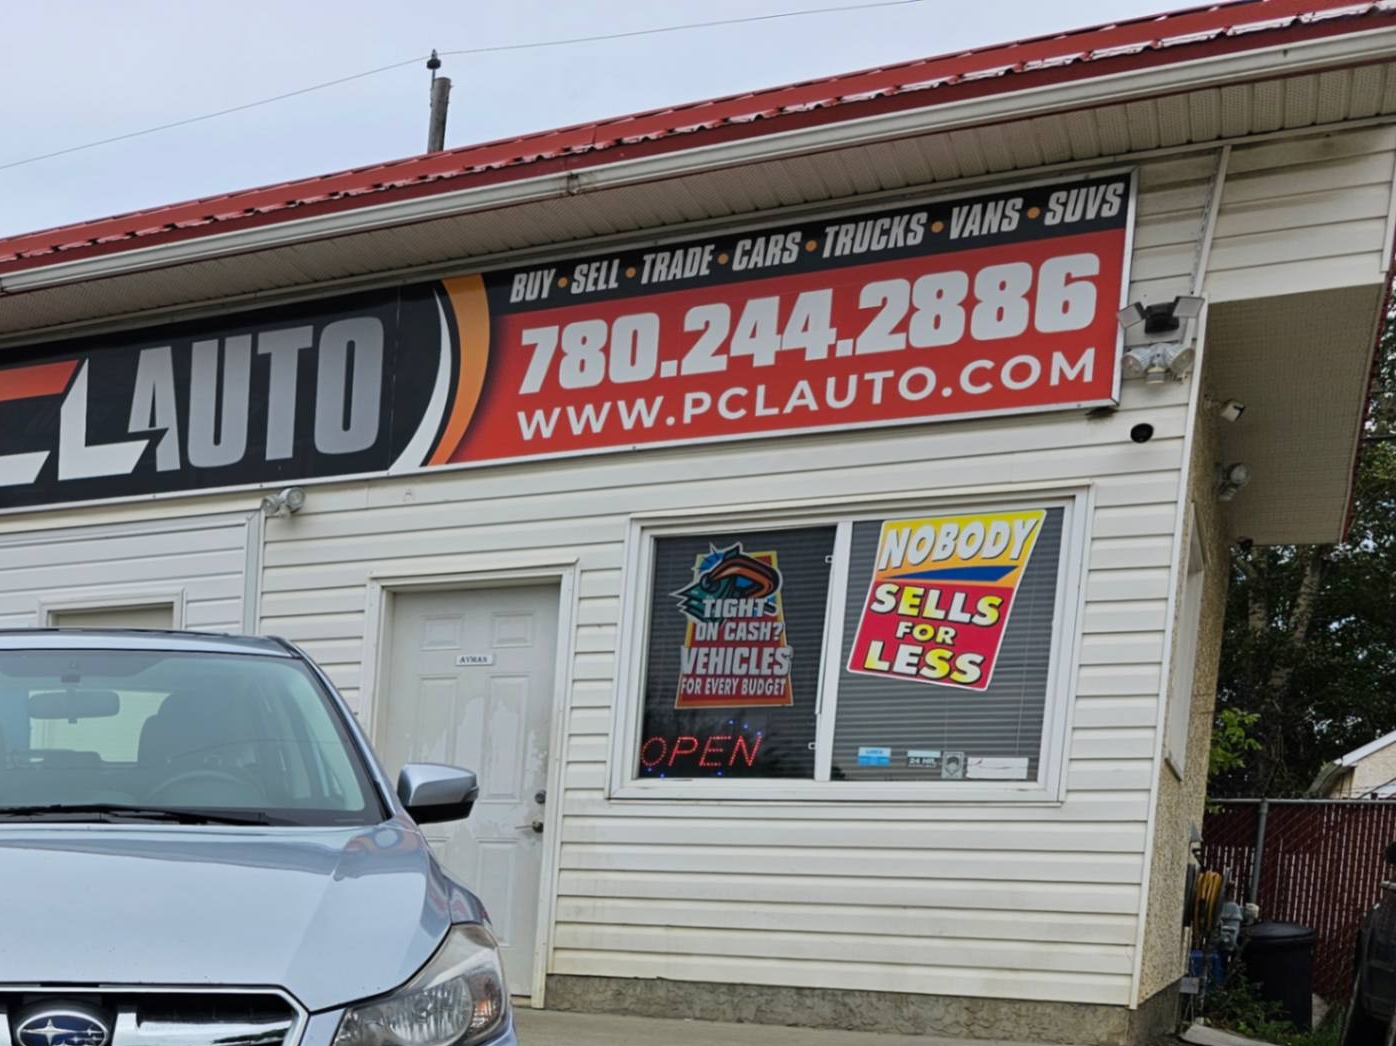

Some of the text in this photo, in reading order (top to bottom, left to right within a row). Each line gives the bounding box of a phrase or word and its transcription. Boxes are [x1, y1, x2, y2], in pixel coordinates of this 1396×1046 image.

[510, 182, 1125, 303] BUY SELL TRADE CARS TRUCKS VANS SUVS
[518, 252, 1100, 394] 780.244.2886
[517, 347, 1095, 440] WWW.PCLAUTO.COM
[878, 519, 1039, 571] NOBODY
[703, 598, 769, 618] TIGHT
[869, 583, 1004, 627] SELLS
[724, 621, 784, 642] CASH?
[895, 621, 957, 645] FOR
[680, 647, 790, 676] VEHICLES
[863, 640, 985, 684] LESS
[680, 677, 788, 696] FOR EVERY BUDGET
[641, 735, 763, 767] OPEN
